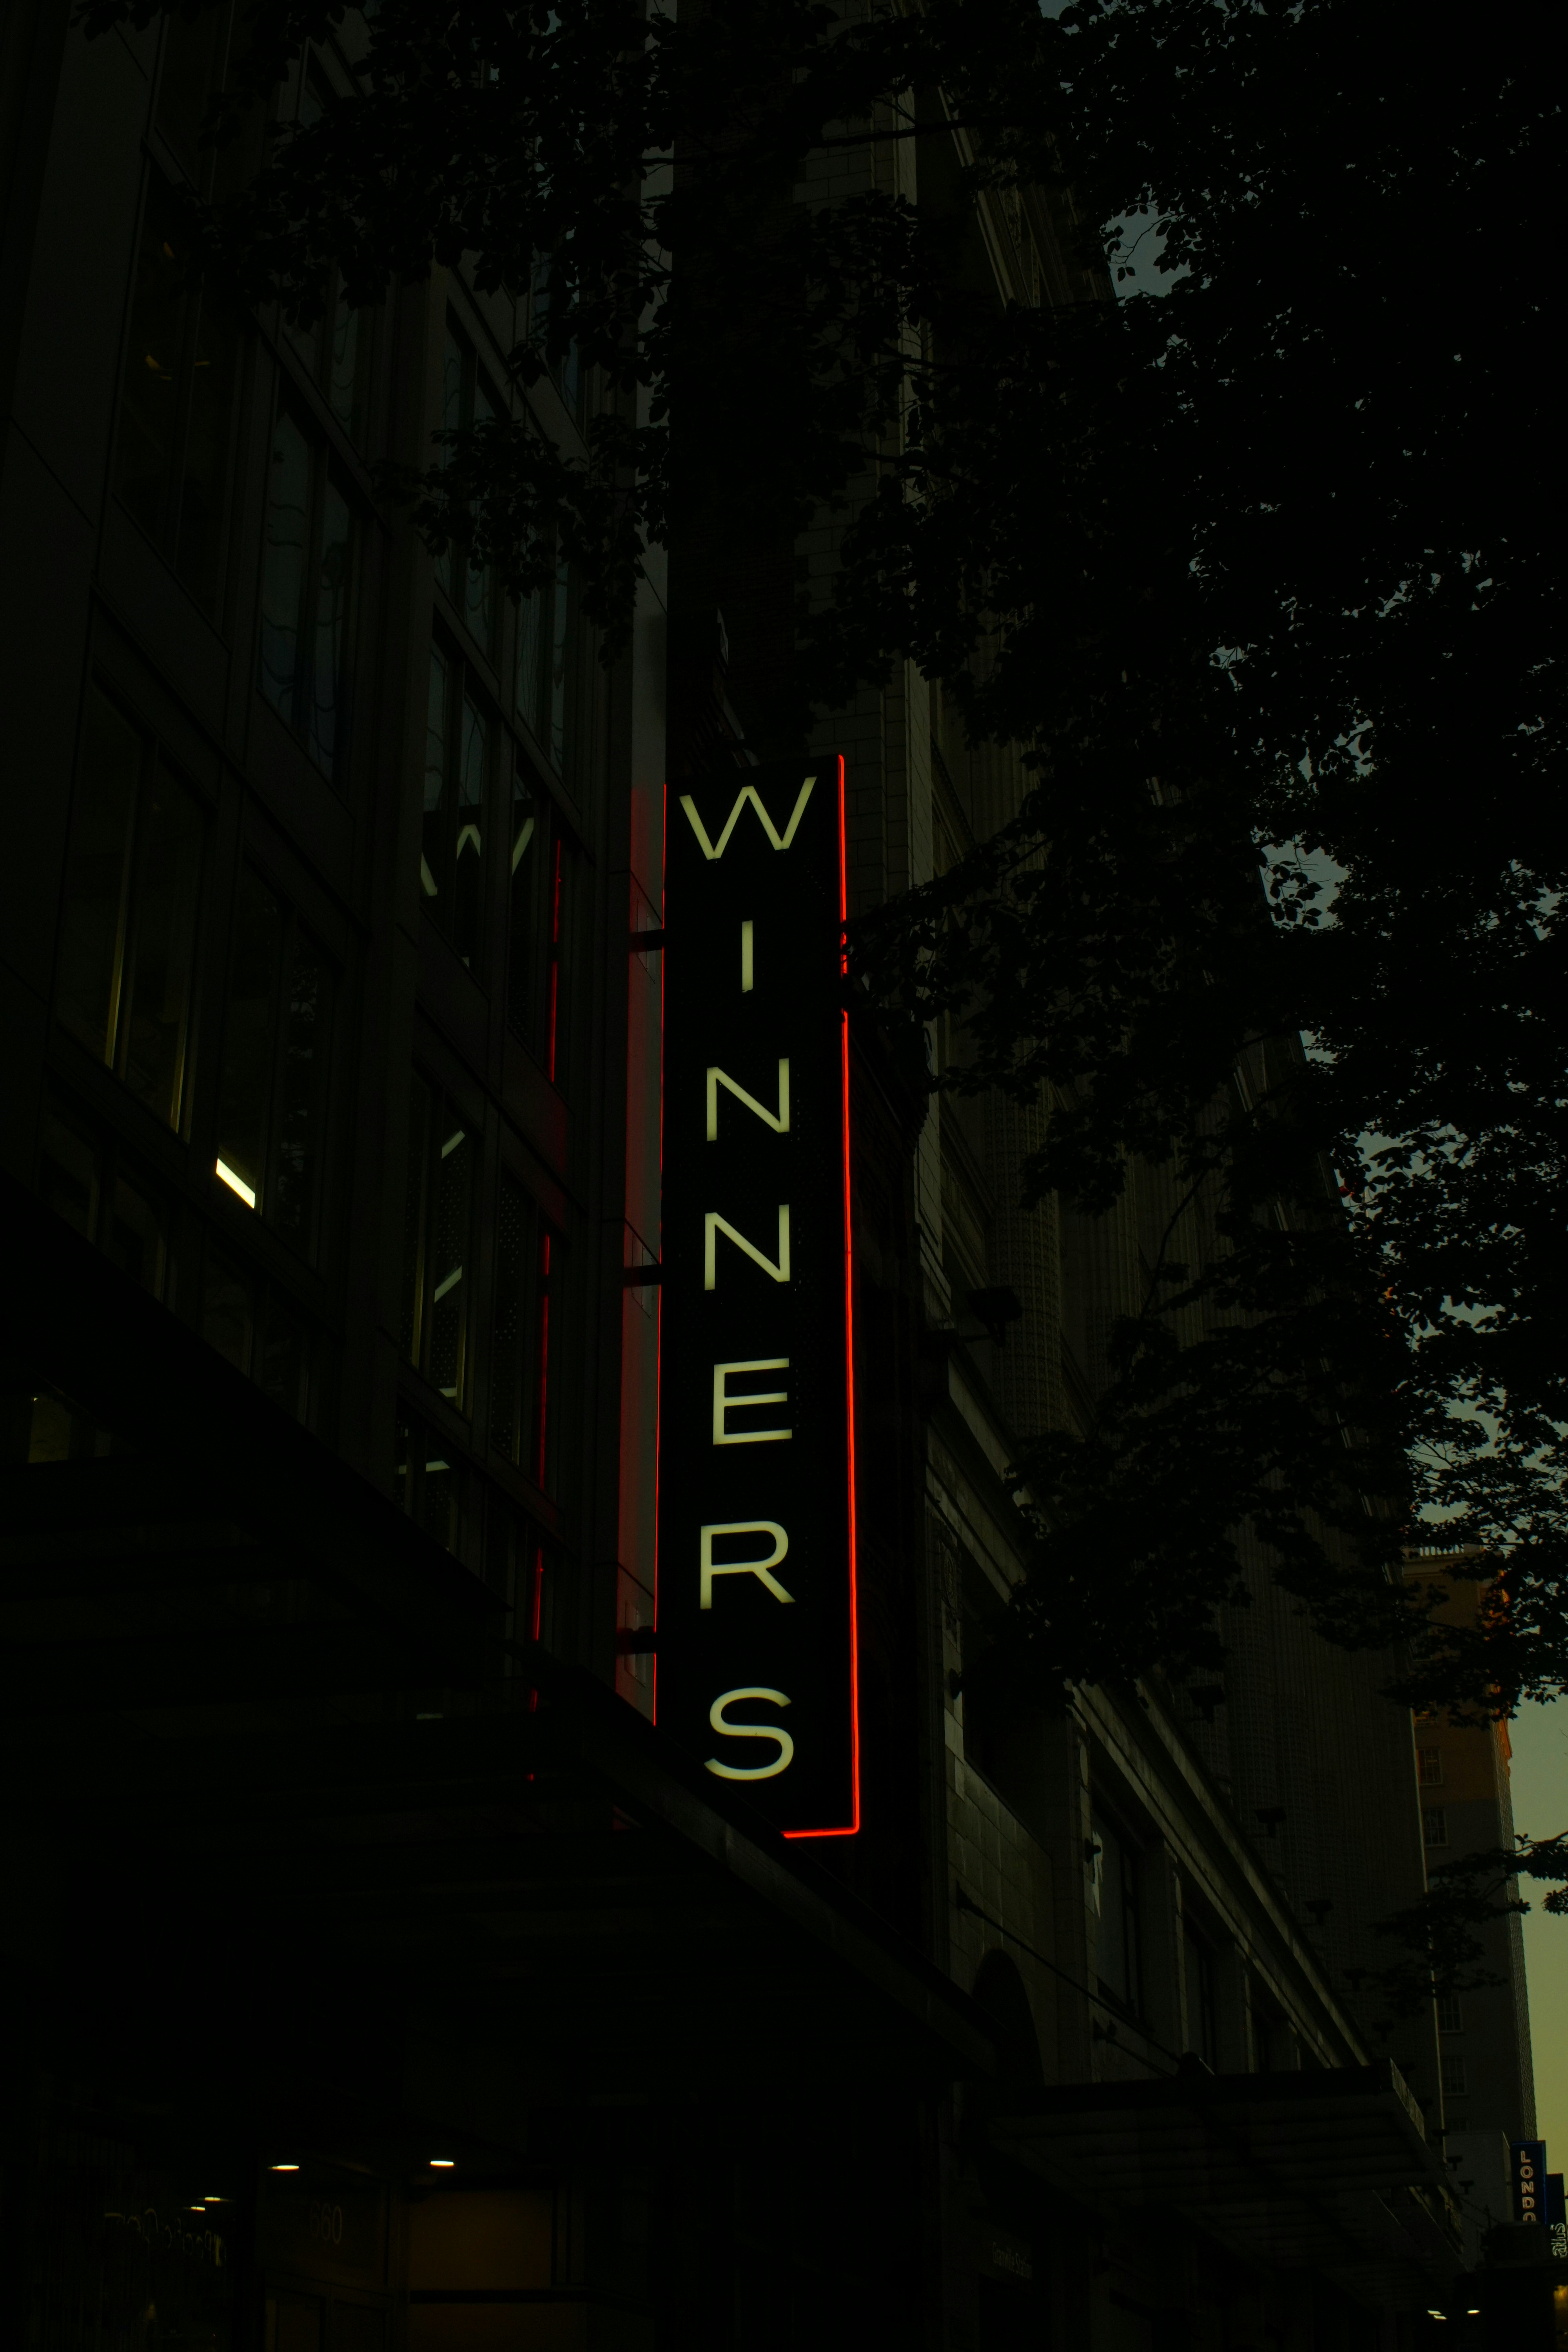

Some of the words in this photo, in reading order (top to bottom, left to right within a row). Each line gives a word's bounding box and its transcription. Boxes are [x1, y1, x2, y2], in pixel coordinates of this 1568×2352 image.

[681, 777, 815, 1782] WINNERS
[140, 1898, 405, 2080] WINNERS
[540, 2111, 839, 2152] WINNERS
[310, 2200, 342, 2246] 660
